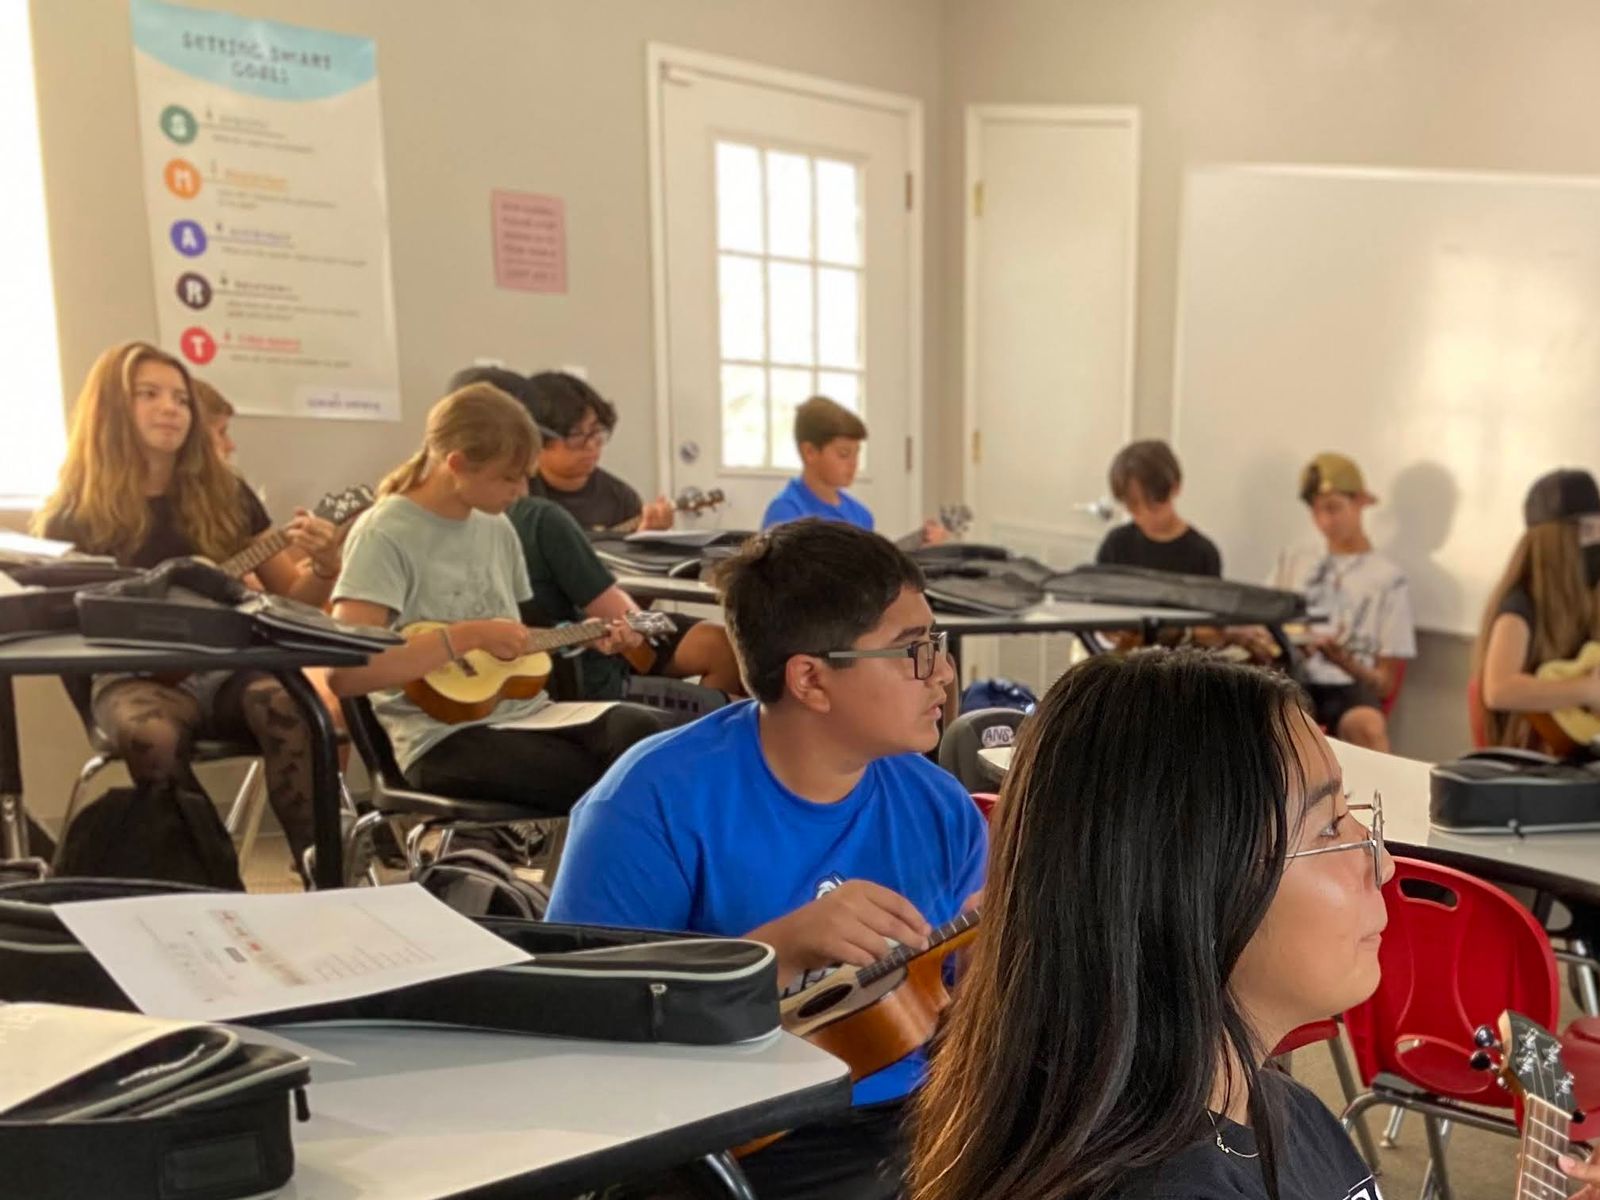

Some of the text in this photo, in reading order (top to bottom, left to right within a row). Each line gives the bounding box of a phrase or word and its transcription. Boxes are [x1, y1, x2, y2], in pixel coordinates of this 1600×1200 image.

[180, 225, 198, 250] A
[185, 279, 204, 305] R
[190, 335, 206, 359] T
